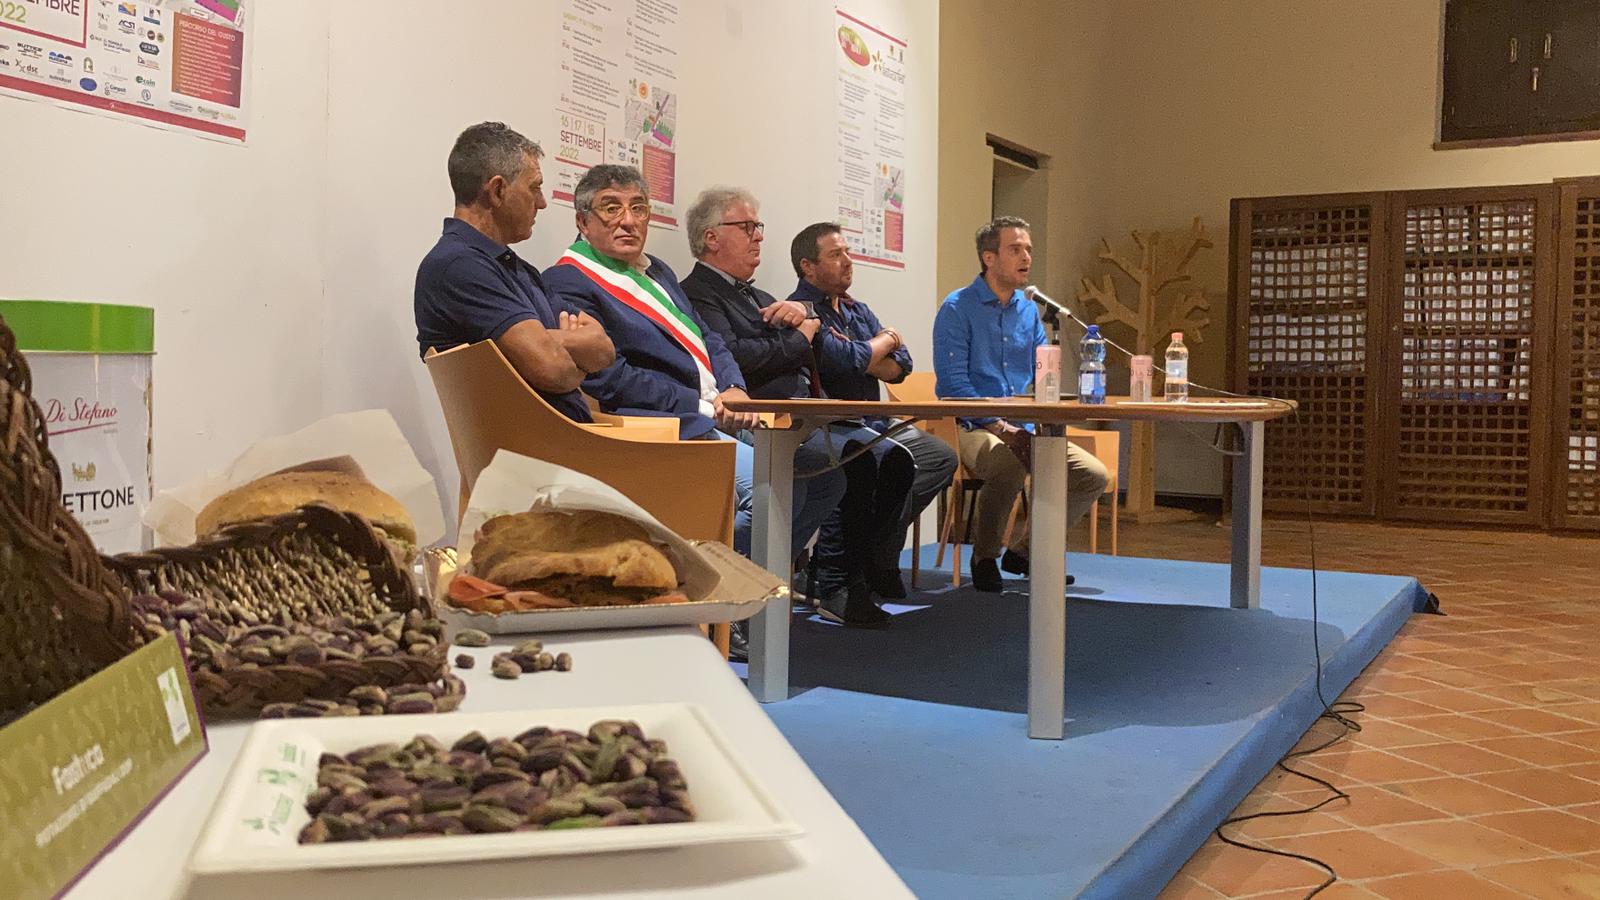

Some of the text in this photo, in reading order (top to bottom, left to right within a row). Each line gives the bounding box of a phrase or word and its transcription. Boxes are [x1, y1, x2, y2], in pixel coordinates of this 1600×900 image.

[560, 130, 602, 153] SETTEMBRE
[46, 397, 118, 425] Di Stefano
